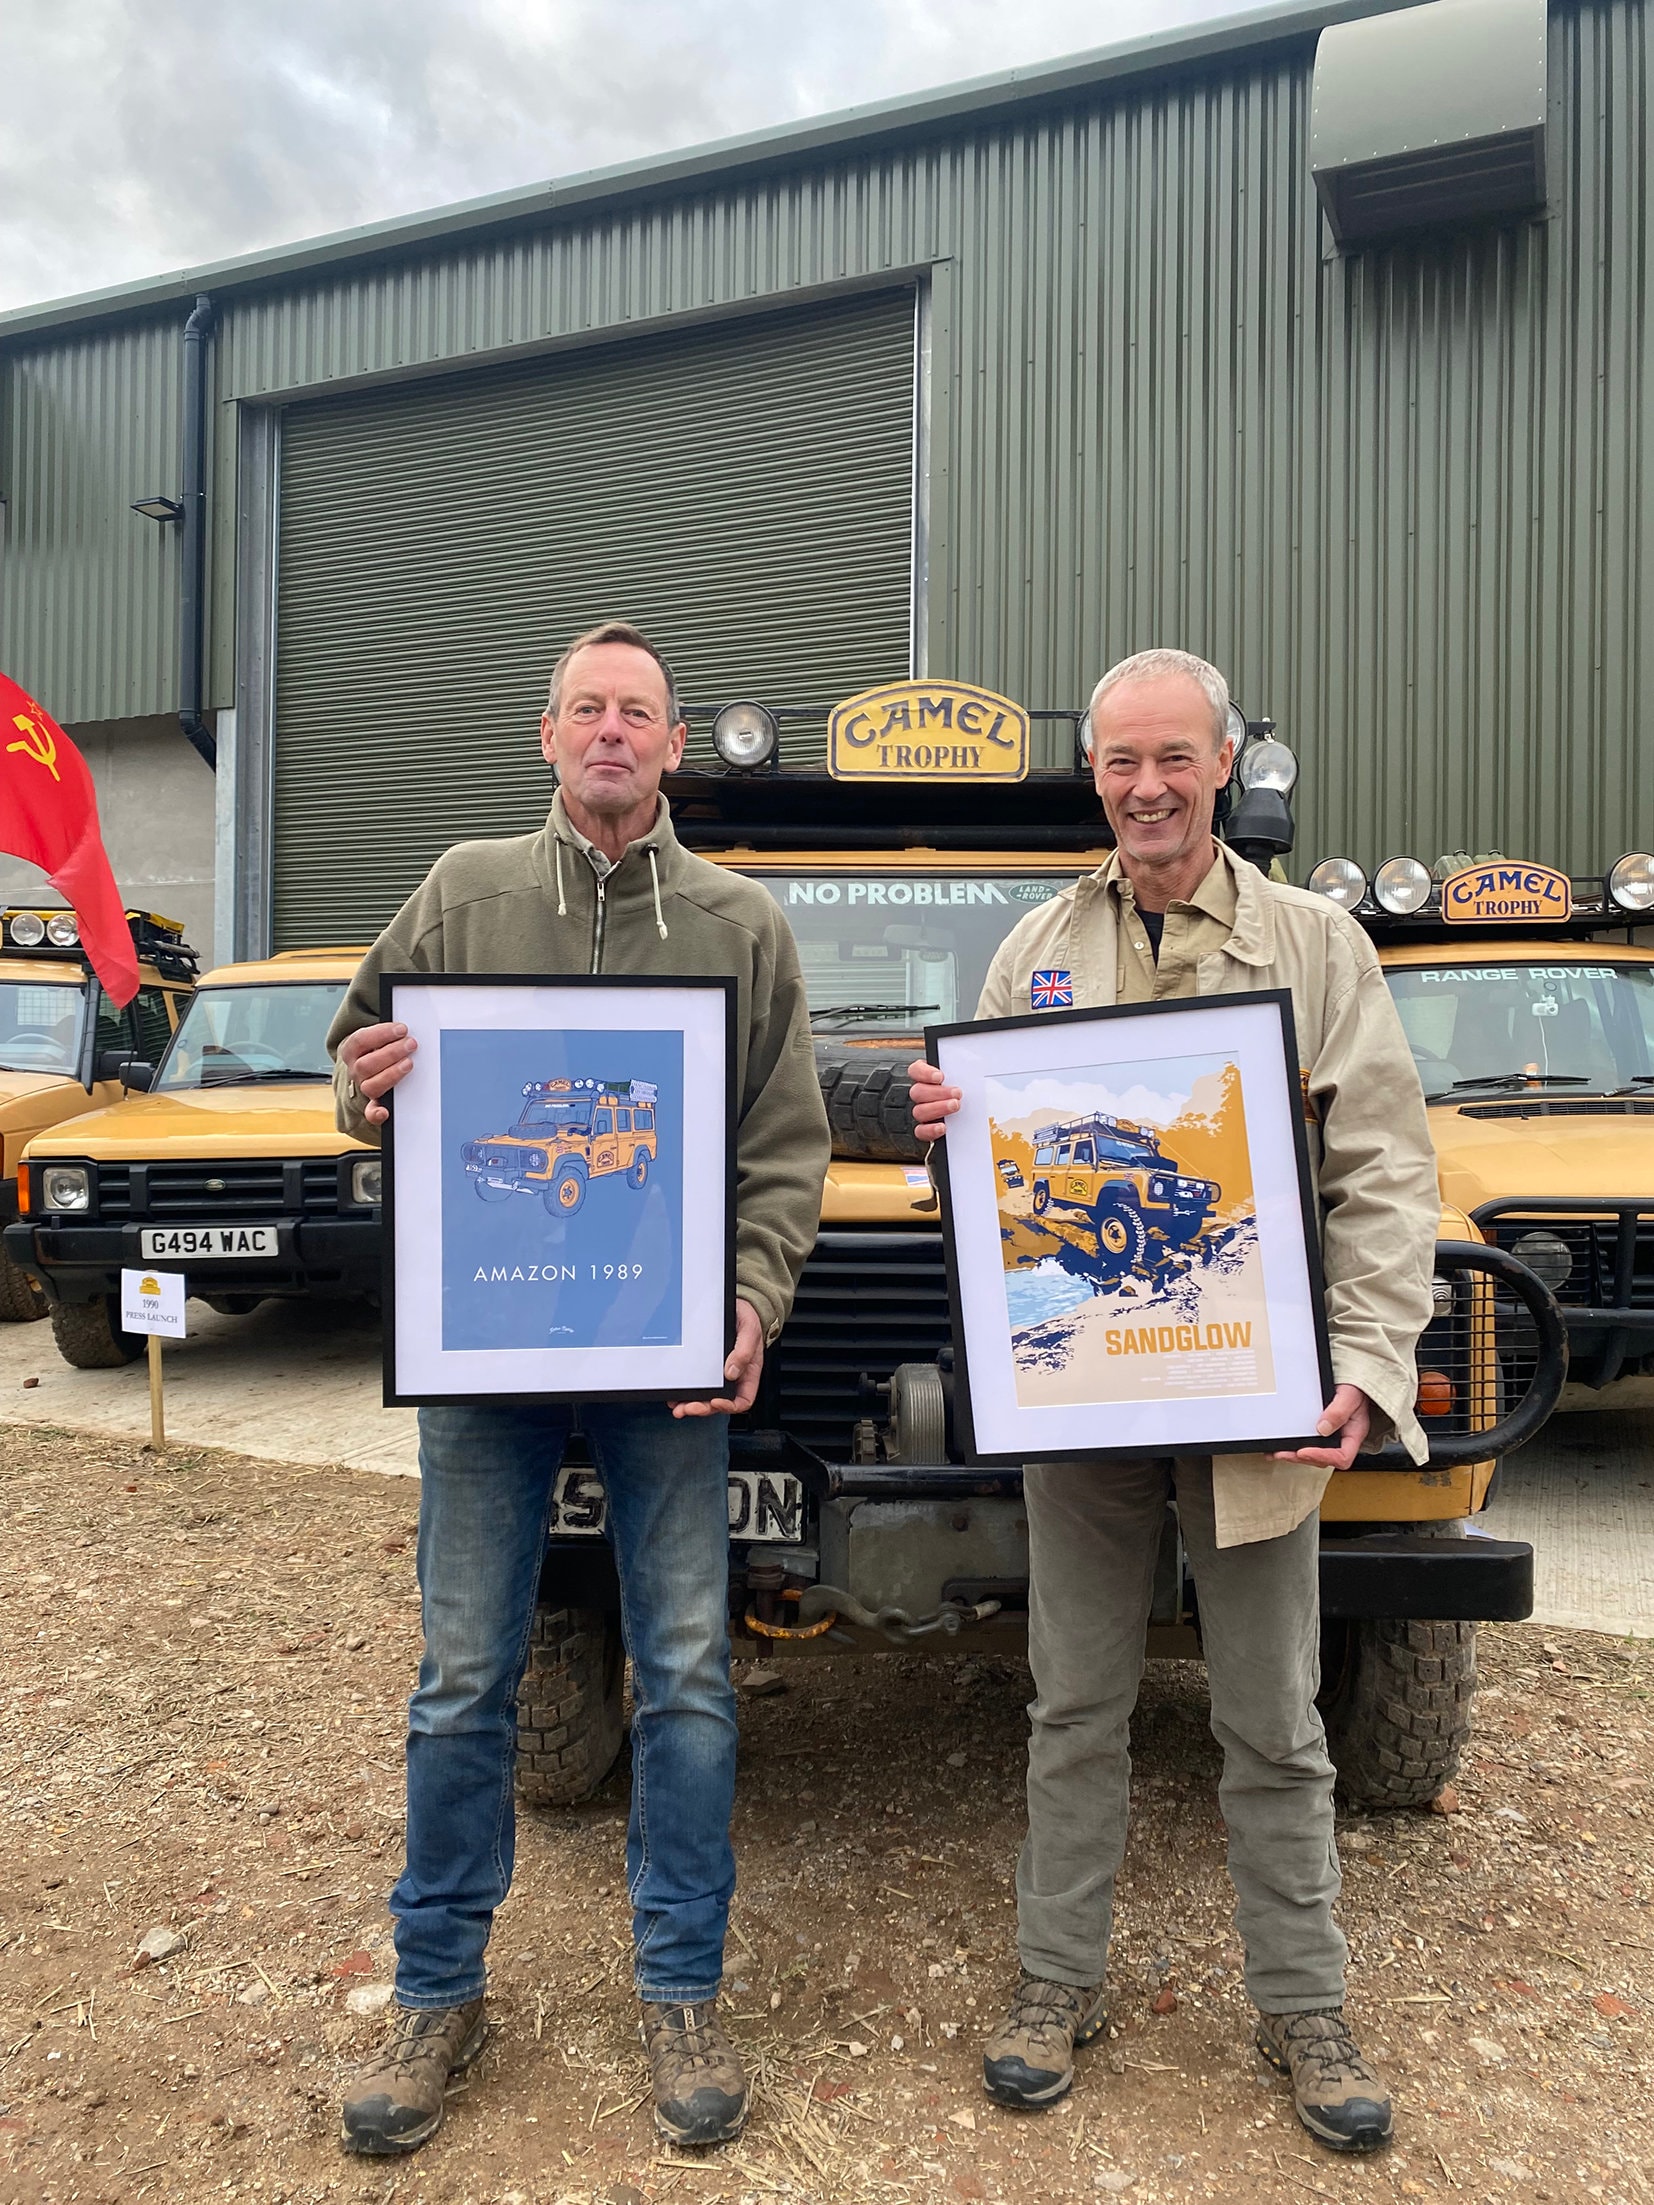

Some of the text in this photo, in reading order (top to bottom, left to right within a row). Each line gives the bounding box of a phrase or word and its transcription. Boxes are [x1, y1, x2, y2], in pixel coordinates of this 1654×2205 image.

[845, 697, 1015, 749] CAMEL
[876, 744, 984, 768] TROPHY
[789, 882, 841, 904] NO
[1452, 870, 1562, 904] CAMEL
[1473, 899, 1543, 916] TROPHY
[1420, 967, 1619, 984] RANGE ROVER
[152, 1230, 267, 1254] G494 WAC
[473, 1264, 643, 1282] AMAZON 1989
[142, 1298, 159, 1310] 1990
[126, 1310, 178, 1324] PRESS LAUNCH
[1105, 1321, 1251, 1356] SANDGLOW
